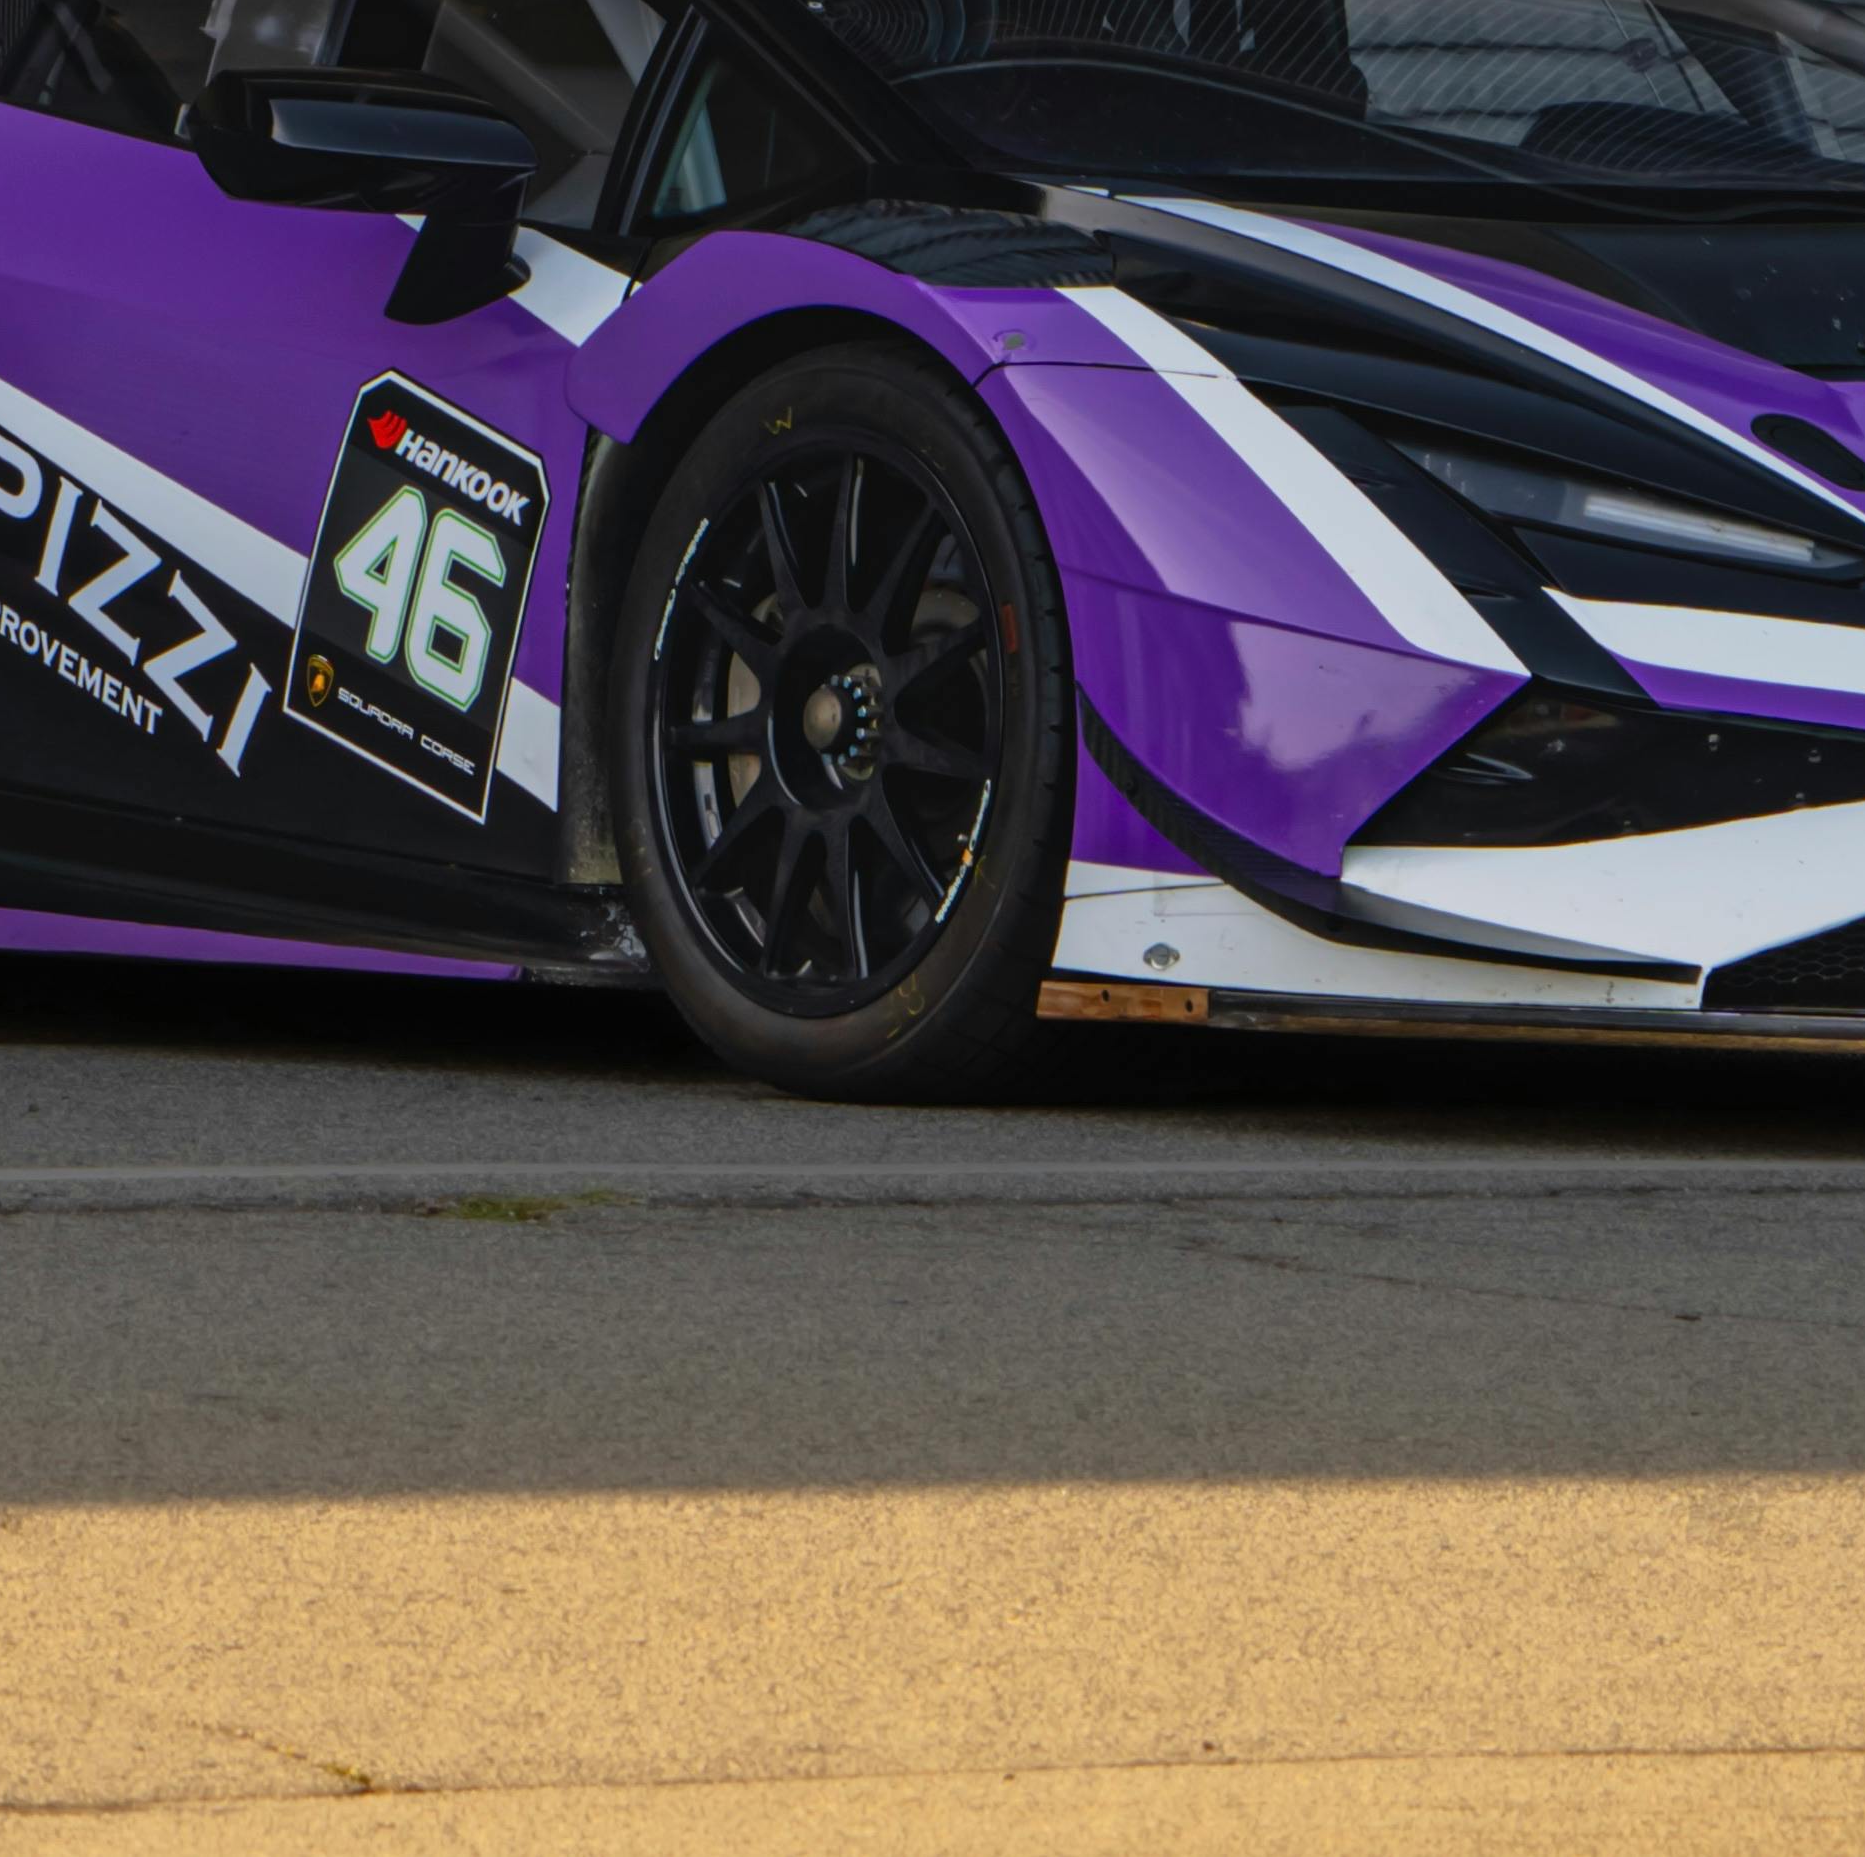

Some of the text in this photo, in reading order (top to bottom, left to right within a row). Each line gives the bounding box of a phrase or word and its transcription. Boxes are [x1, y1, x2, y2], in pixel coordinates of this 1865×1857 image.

[332, 483, 508, 715] 46
[336, 685, 477, 778] SQUADRA CORSE
